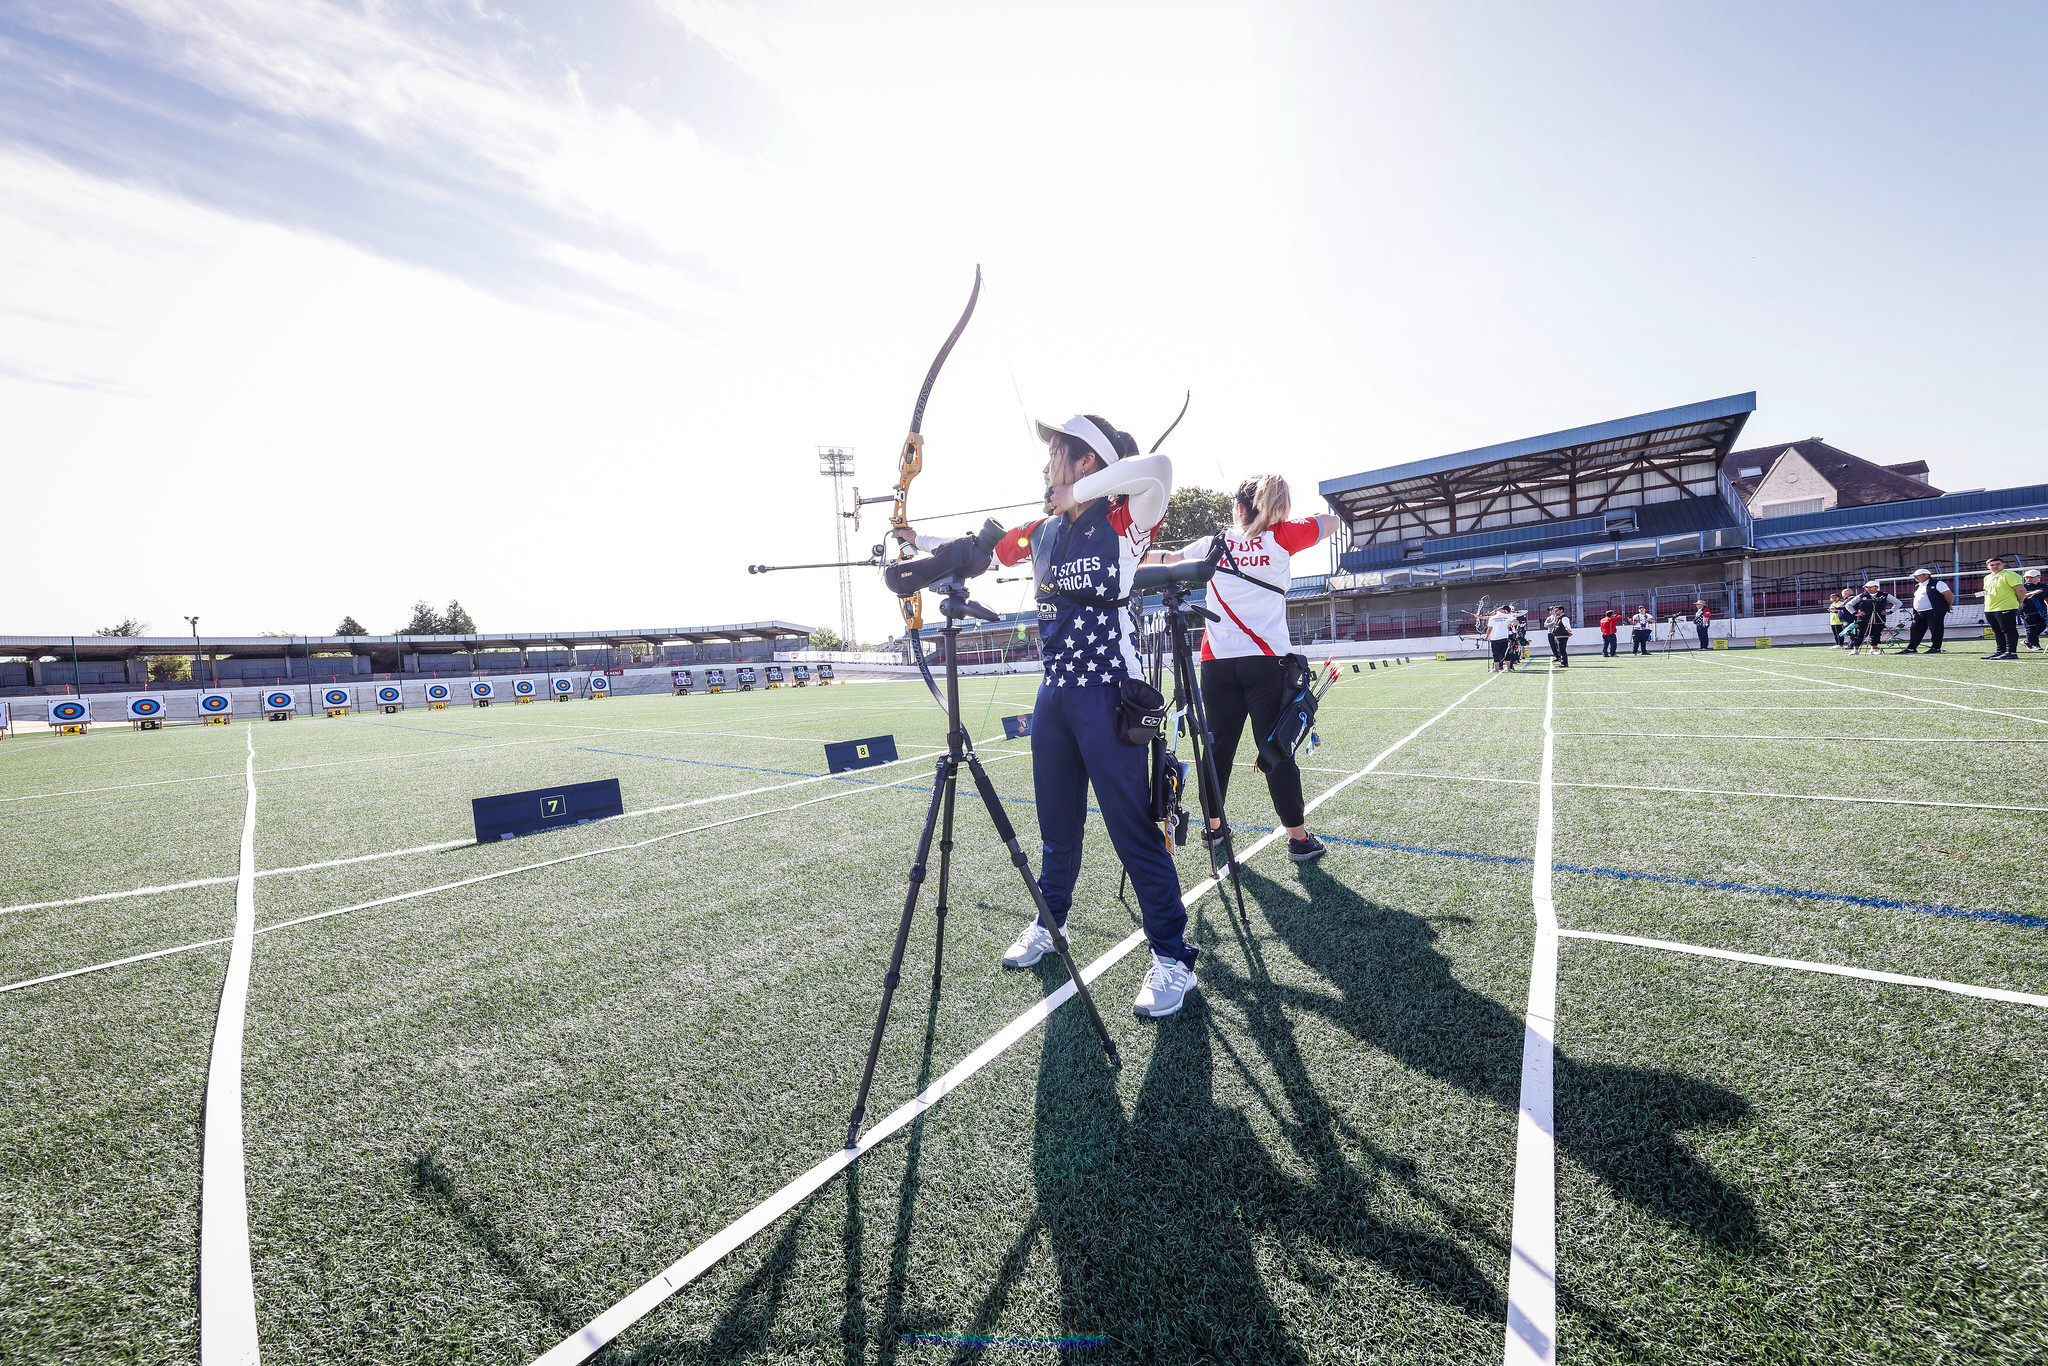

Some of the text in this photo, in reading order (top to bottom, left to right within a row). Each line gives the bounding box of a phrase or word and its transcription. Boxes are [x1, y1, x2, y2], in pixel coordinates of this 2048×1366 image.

[1227, 536, 1263, 552] TUR
[1058, 556, 1101, 577] STATES
[1220, 555, 1270, 567] KOCUR
[860, 747, 866, 756] 8
[547, 800, 558, 812] 7
